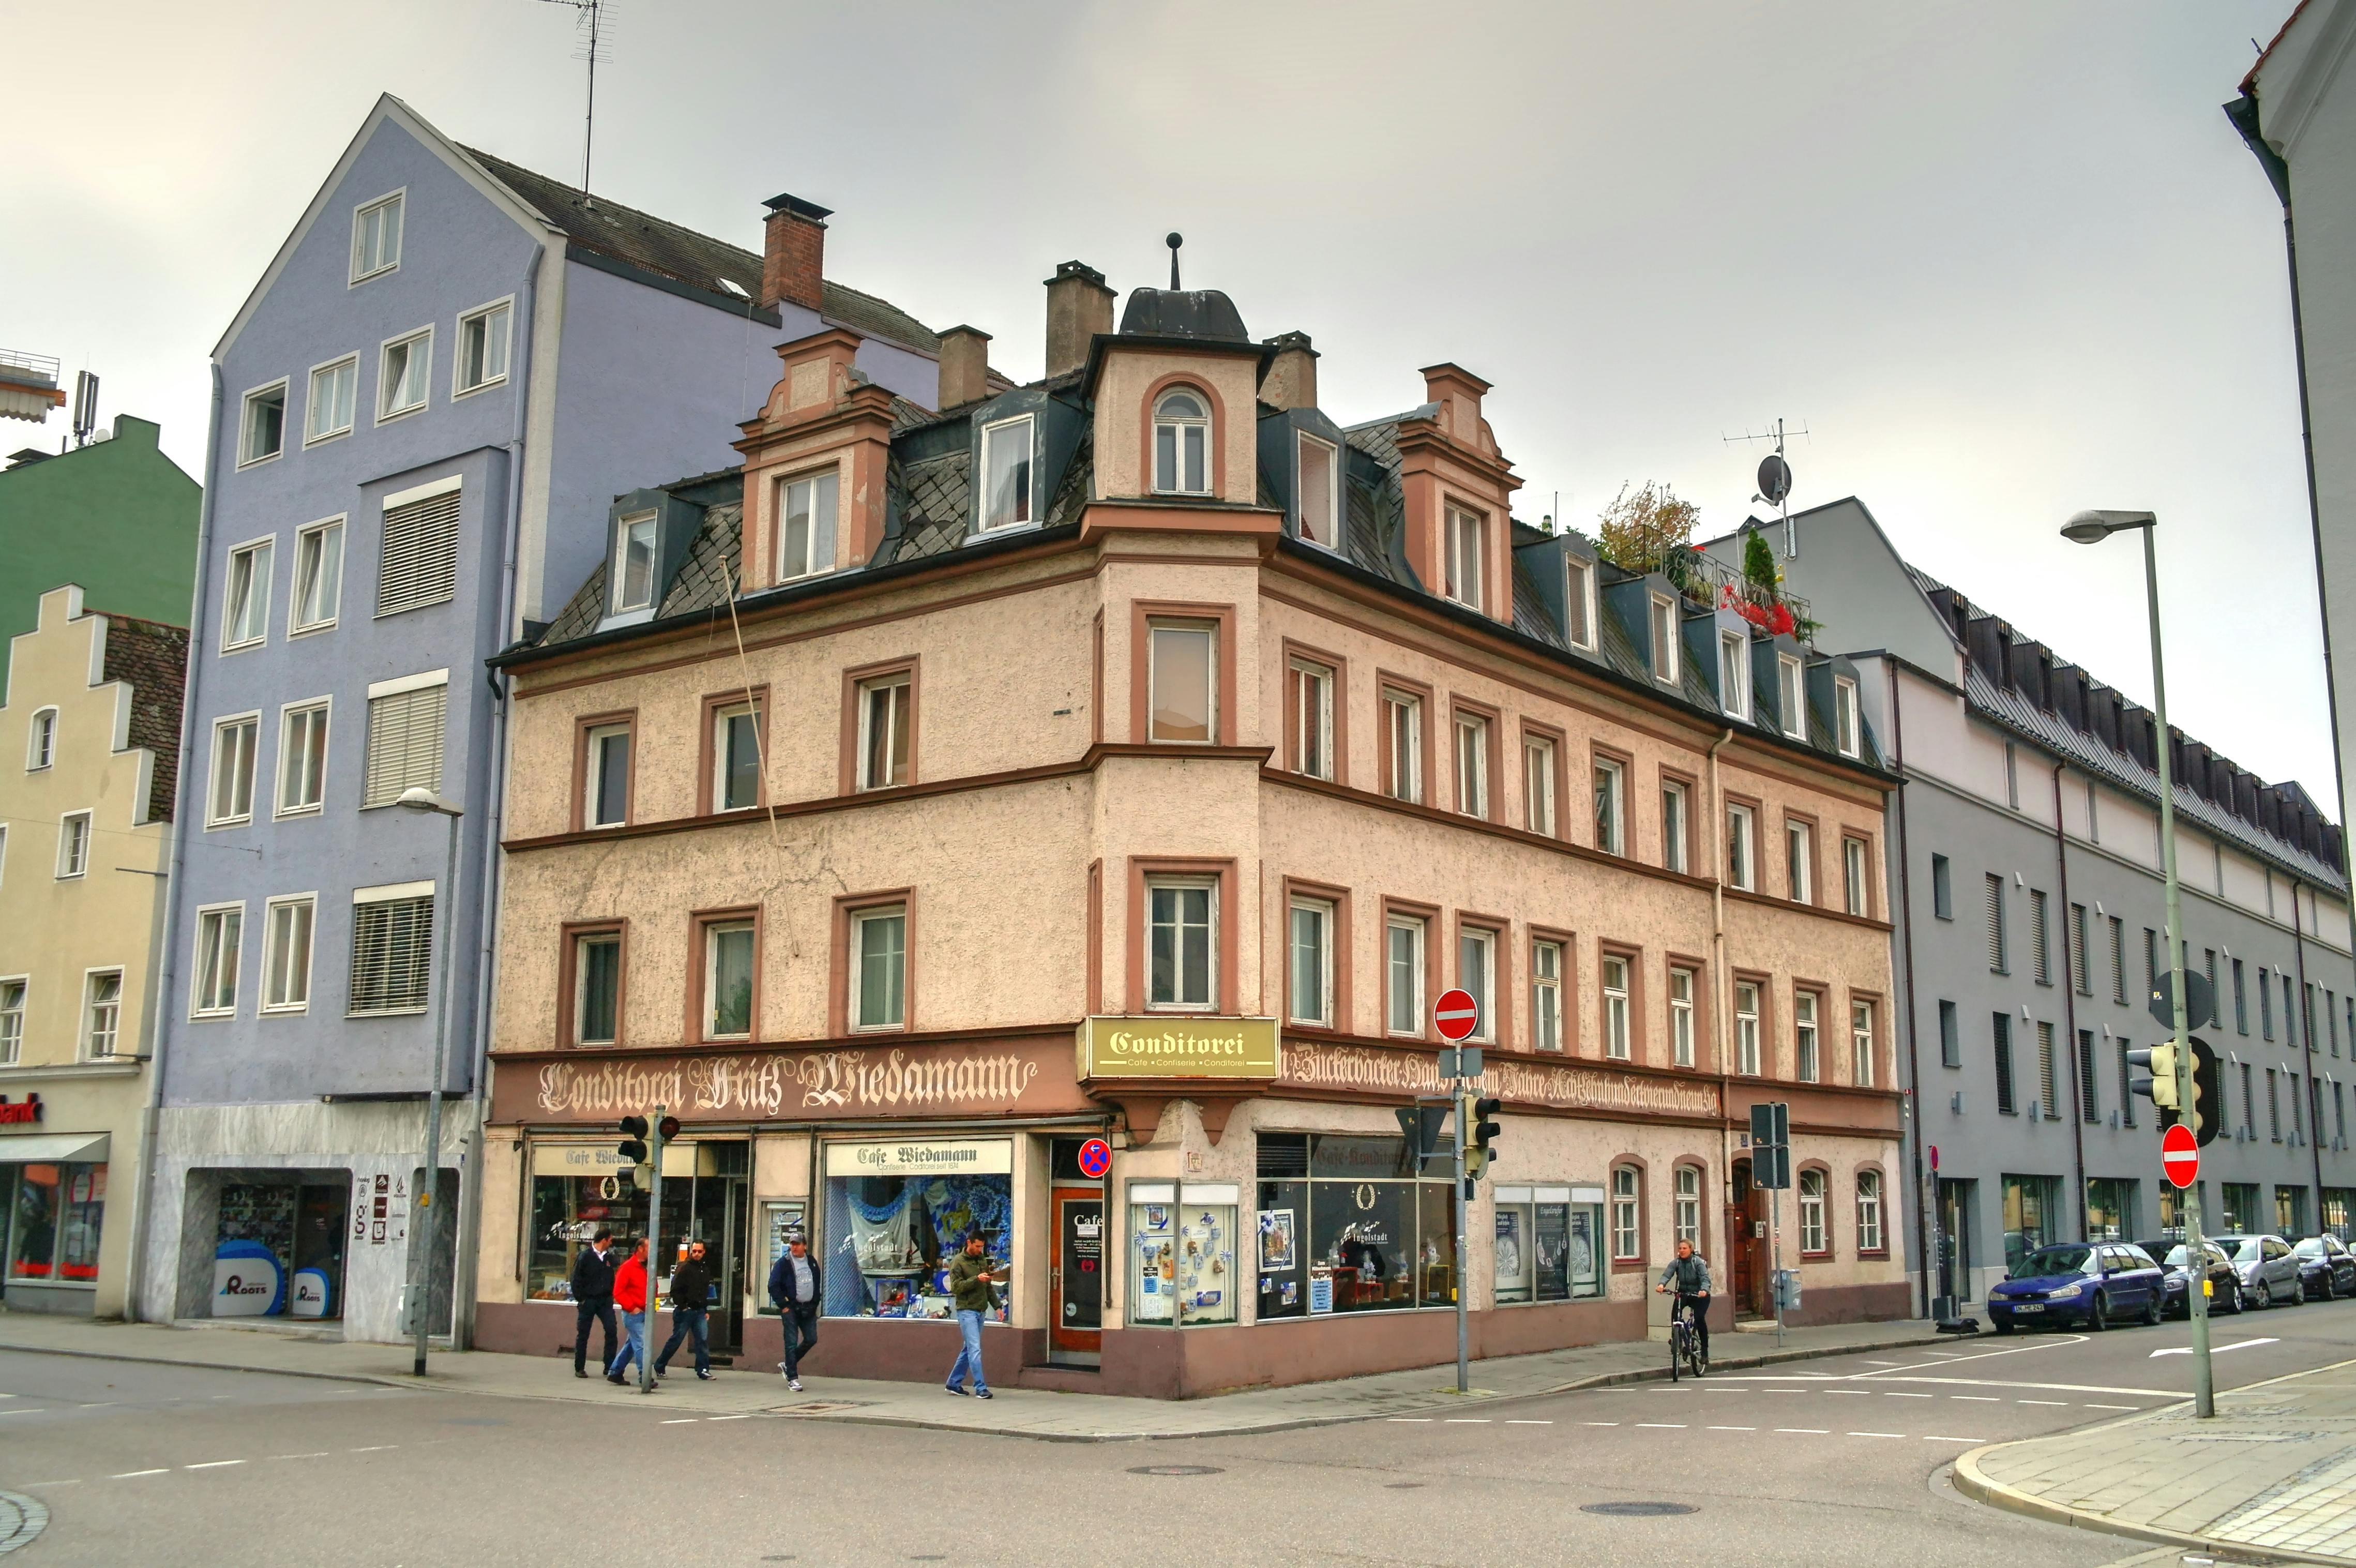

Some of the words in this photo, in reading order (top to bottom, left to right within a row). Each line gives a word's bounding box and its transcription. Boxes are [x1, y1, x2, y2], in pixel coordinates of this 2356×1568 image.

[1110, 1032, 1244, 1055] Conditorei
[1204, 1059, 1245, 1067] Conditorei
[538, 1060, 685, 1115] Conditorei
[688, 1055, 796, 1115] Fritz
[797, 1049, 1038, 1108] Wiedamann
[566, 1150, 590, 1166] Cafe
[857, 1148, 887, 1167] Cafe
[898, 1147, 977, 1163] Wiedamann
[1074, 1214, 1103, 1227] Cafe
[559, 1230, 594, 1240] Ingolstadt
[1353, 1232, 1387, 1244] Ingolstadt
[854, 1243, 898, 1252] Ingolstadt
